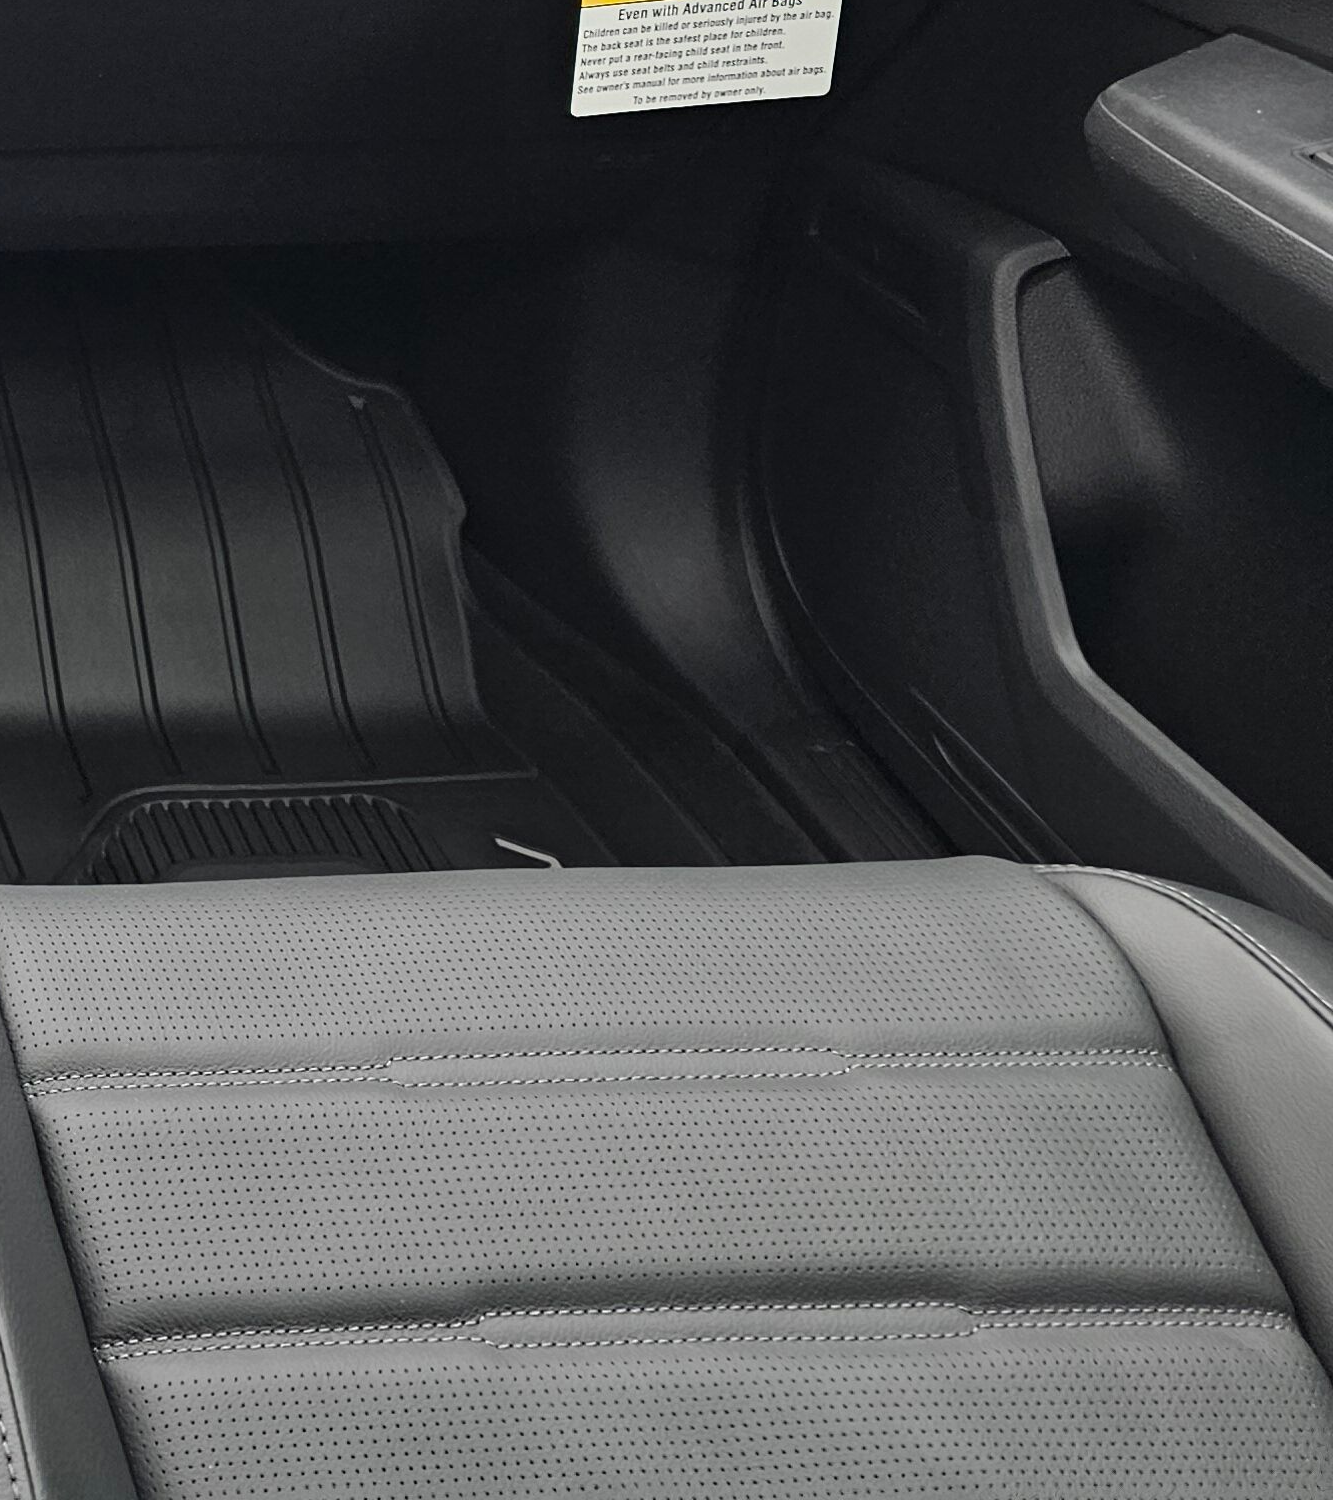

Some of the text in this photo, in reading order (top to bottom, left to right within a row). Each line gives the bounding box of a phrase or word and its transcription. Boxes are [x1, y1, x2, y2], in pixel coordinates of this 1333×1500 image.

[583, 10, 835, 39] Children can be killed or seriously injured by the air bag.
[618, 9, 648, 21] Even
[653, 4, 678, 19] with
[582, 27, 786, 53] The back seat is the safest place for children.
[580, 41, 785, 67] Never put a rear-facing child seat in the front.
[577, 65, 827, 95] See owner's manual for more information about air bags.
[579, 56, 768, 81] Always use seat belts and child restraints.
[633, 86, 766, 105] To be removed by owner only.
